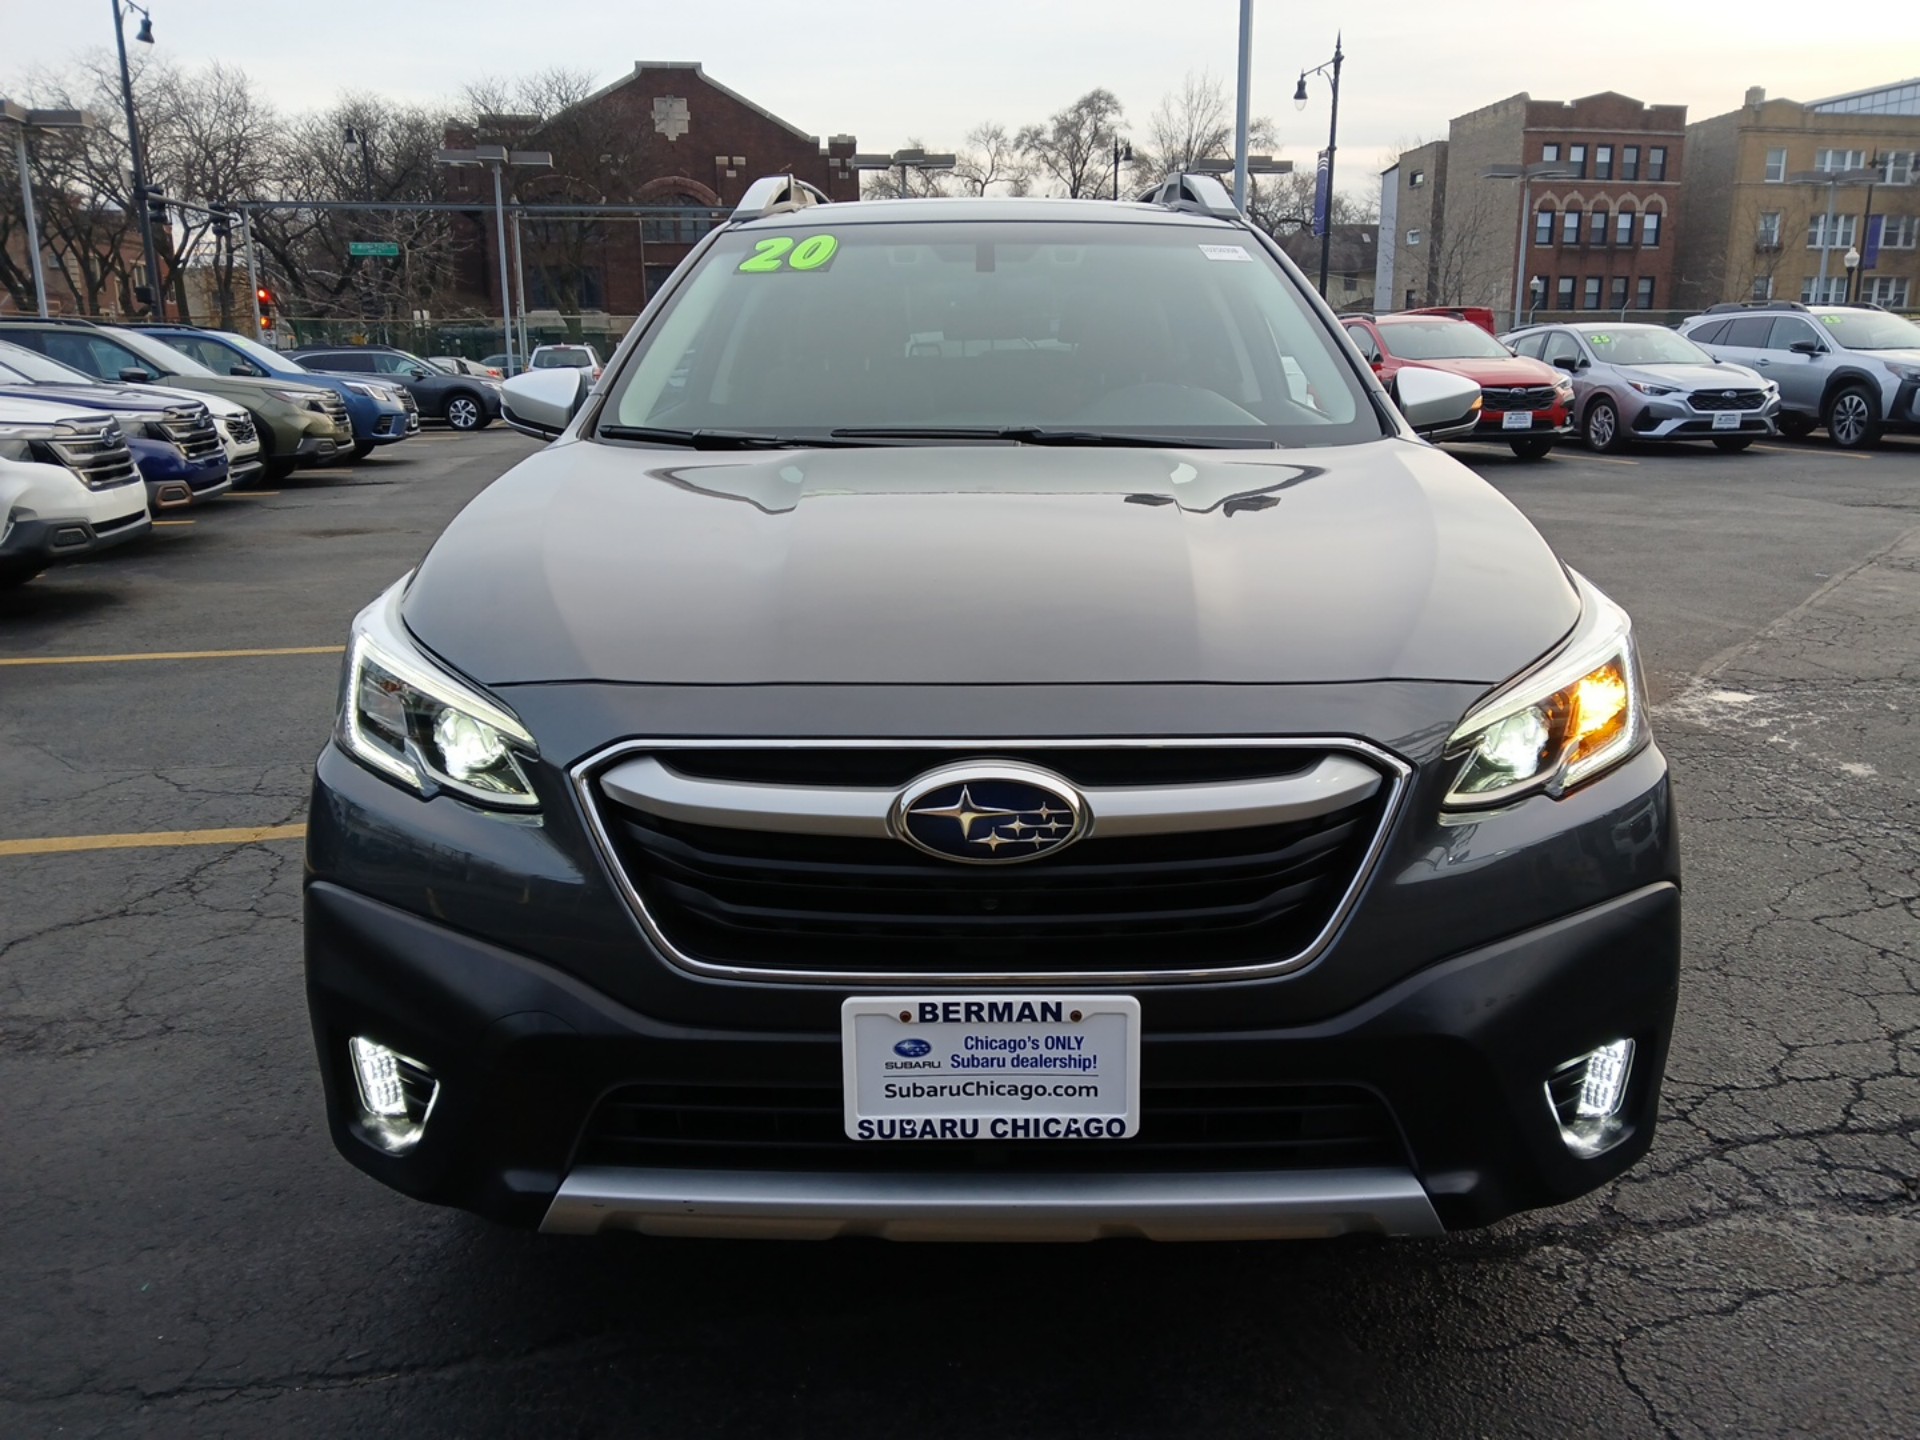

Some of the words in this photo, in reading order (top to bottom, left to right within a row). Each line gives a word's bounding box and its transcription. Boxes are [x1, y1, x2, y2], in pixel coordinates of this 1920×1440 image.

[738, 234, 838, 272] 20
[918, 1002, 1063, 1023] BERMAN
[964, 1036, 1040, 1053] Chicago's
[1044, 1036, 1085, 1050] ONLY
[884, 1061, 941, 1070] SUBARU
[950, 1055, 1006, 1069] Subaru
[1011, 1055, 1098, 1072] dealership!
[884, 1080, 1099, 1101] SubaruChicago.com
[857, 1118, 979, 1140] SUBARU
[990, 1118, 1126, 1139] CHICAGO
